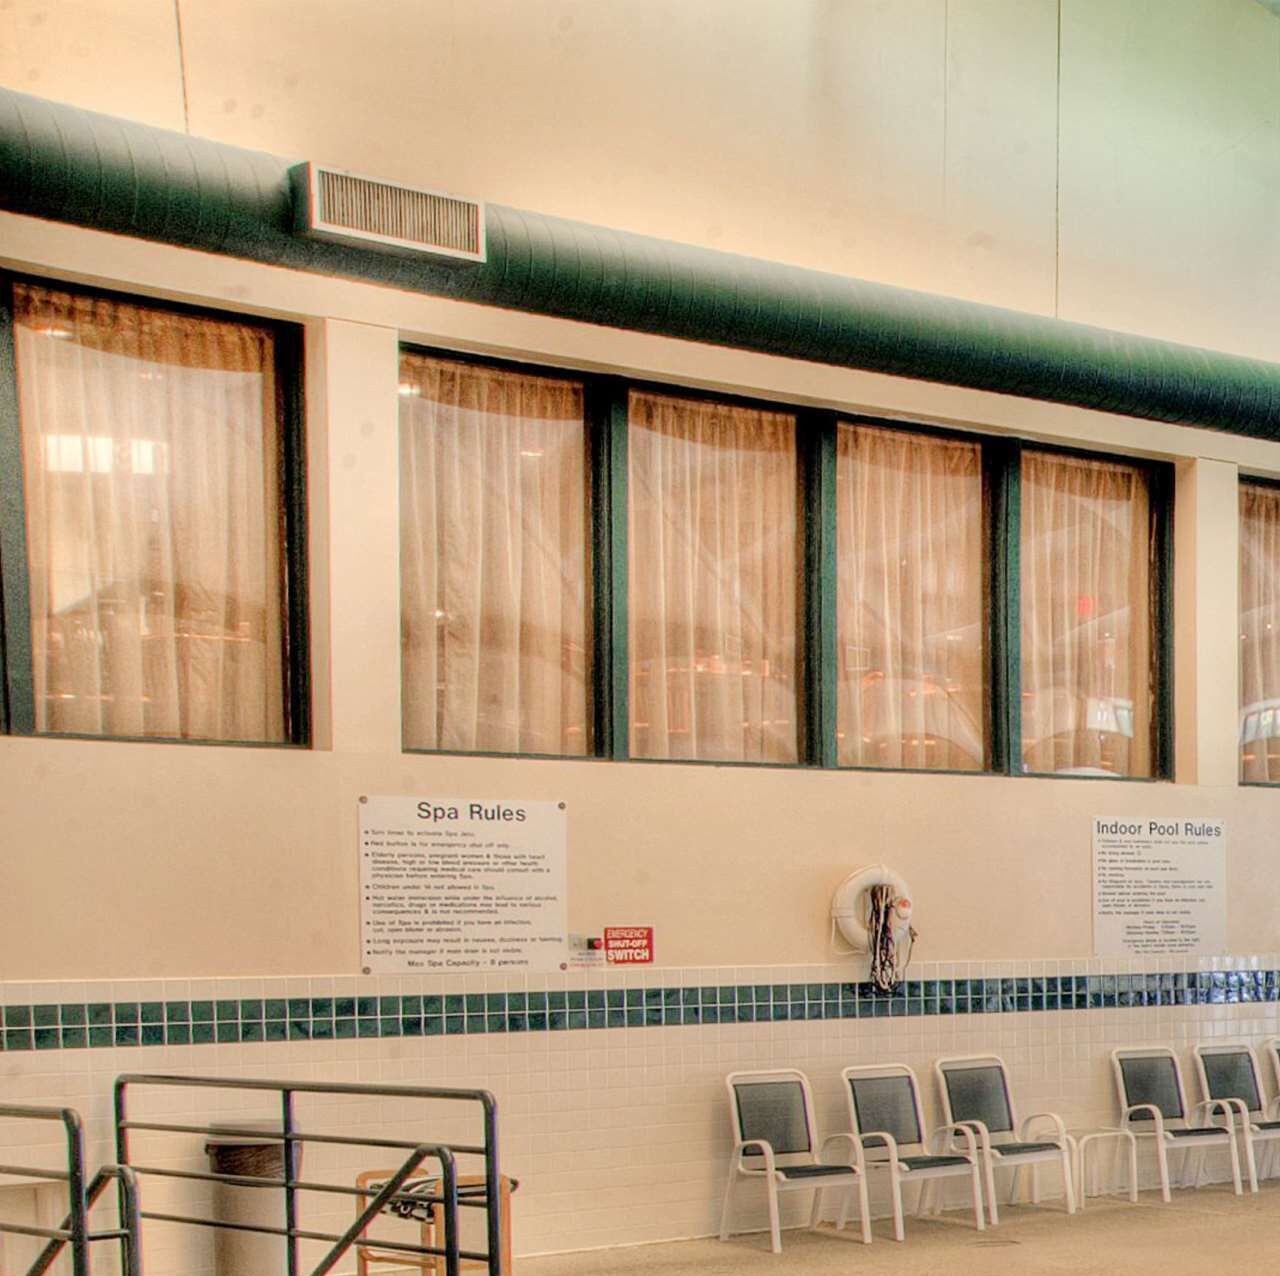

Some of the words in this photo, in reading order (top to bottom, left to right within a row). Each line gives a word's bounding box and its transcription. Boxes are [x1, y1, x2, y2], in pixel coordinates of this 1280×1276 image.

[417, 802, 458, 822] Spa
[469, 804, 526, 822] Rules
[1096, 820, 1142, 834] Indoor
[1149, 821, 1179, 836] Pool
[1184, 822, 1222, 837] Rules
[608, 940, 648, 948] SHUT-OFF
[608, 949, 649, 960] SWITCH
